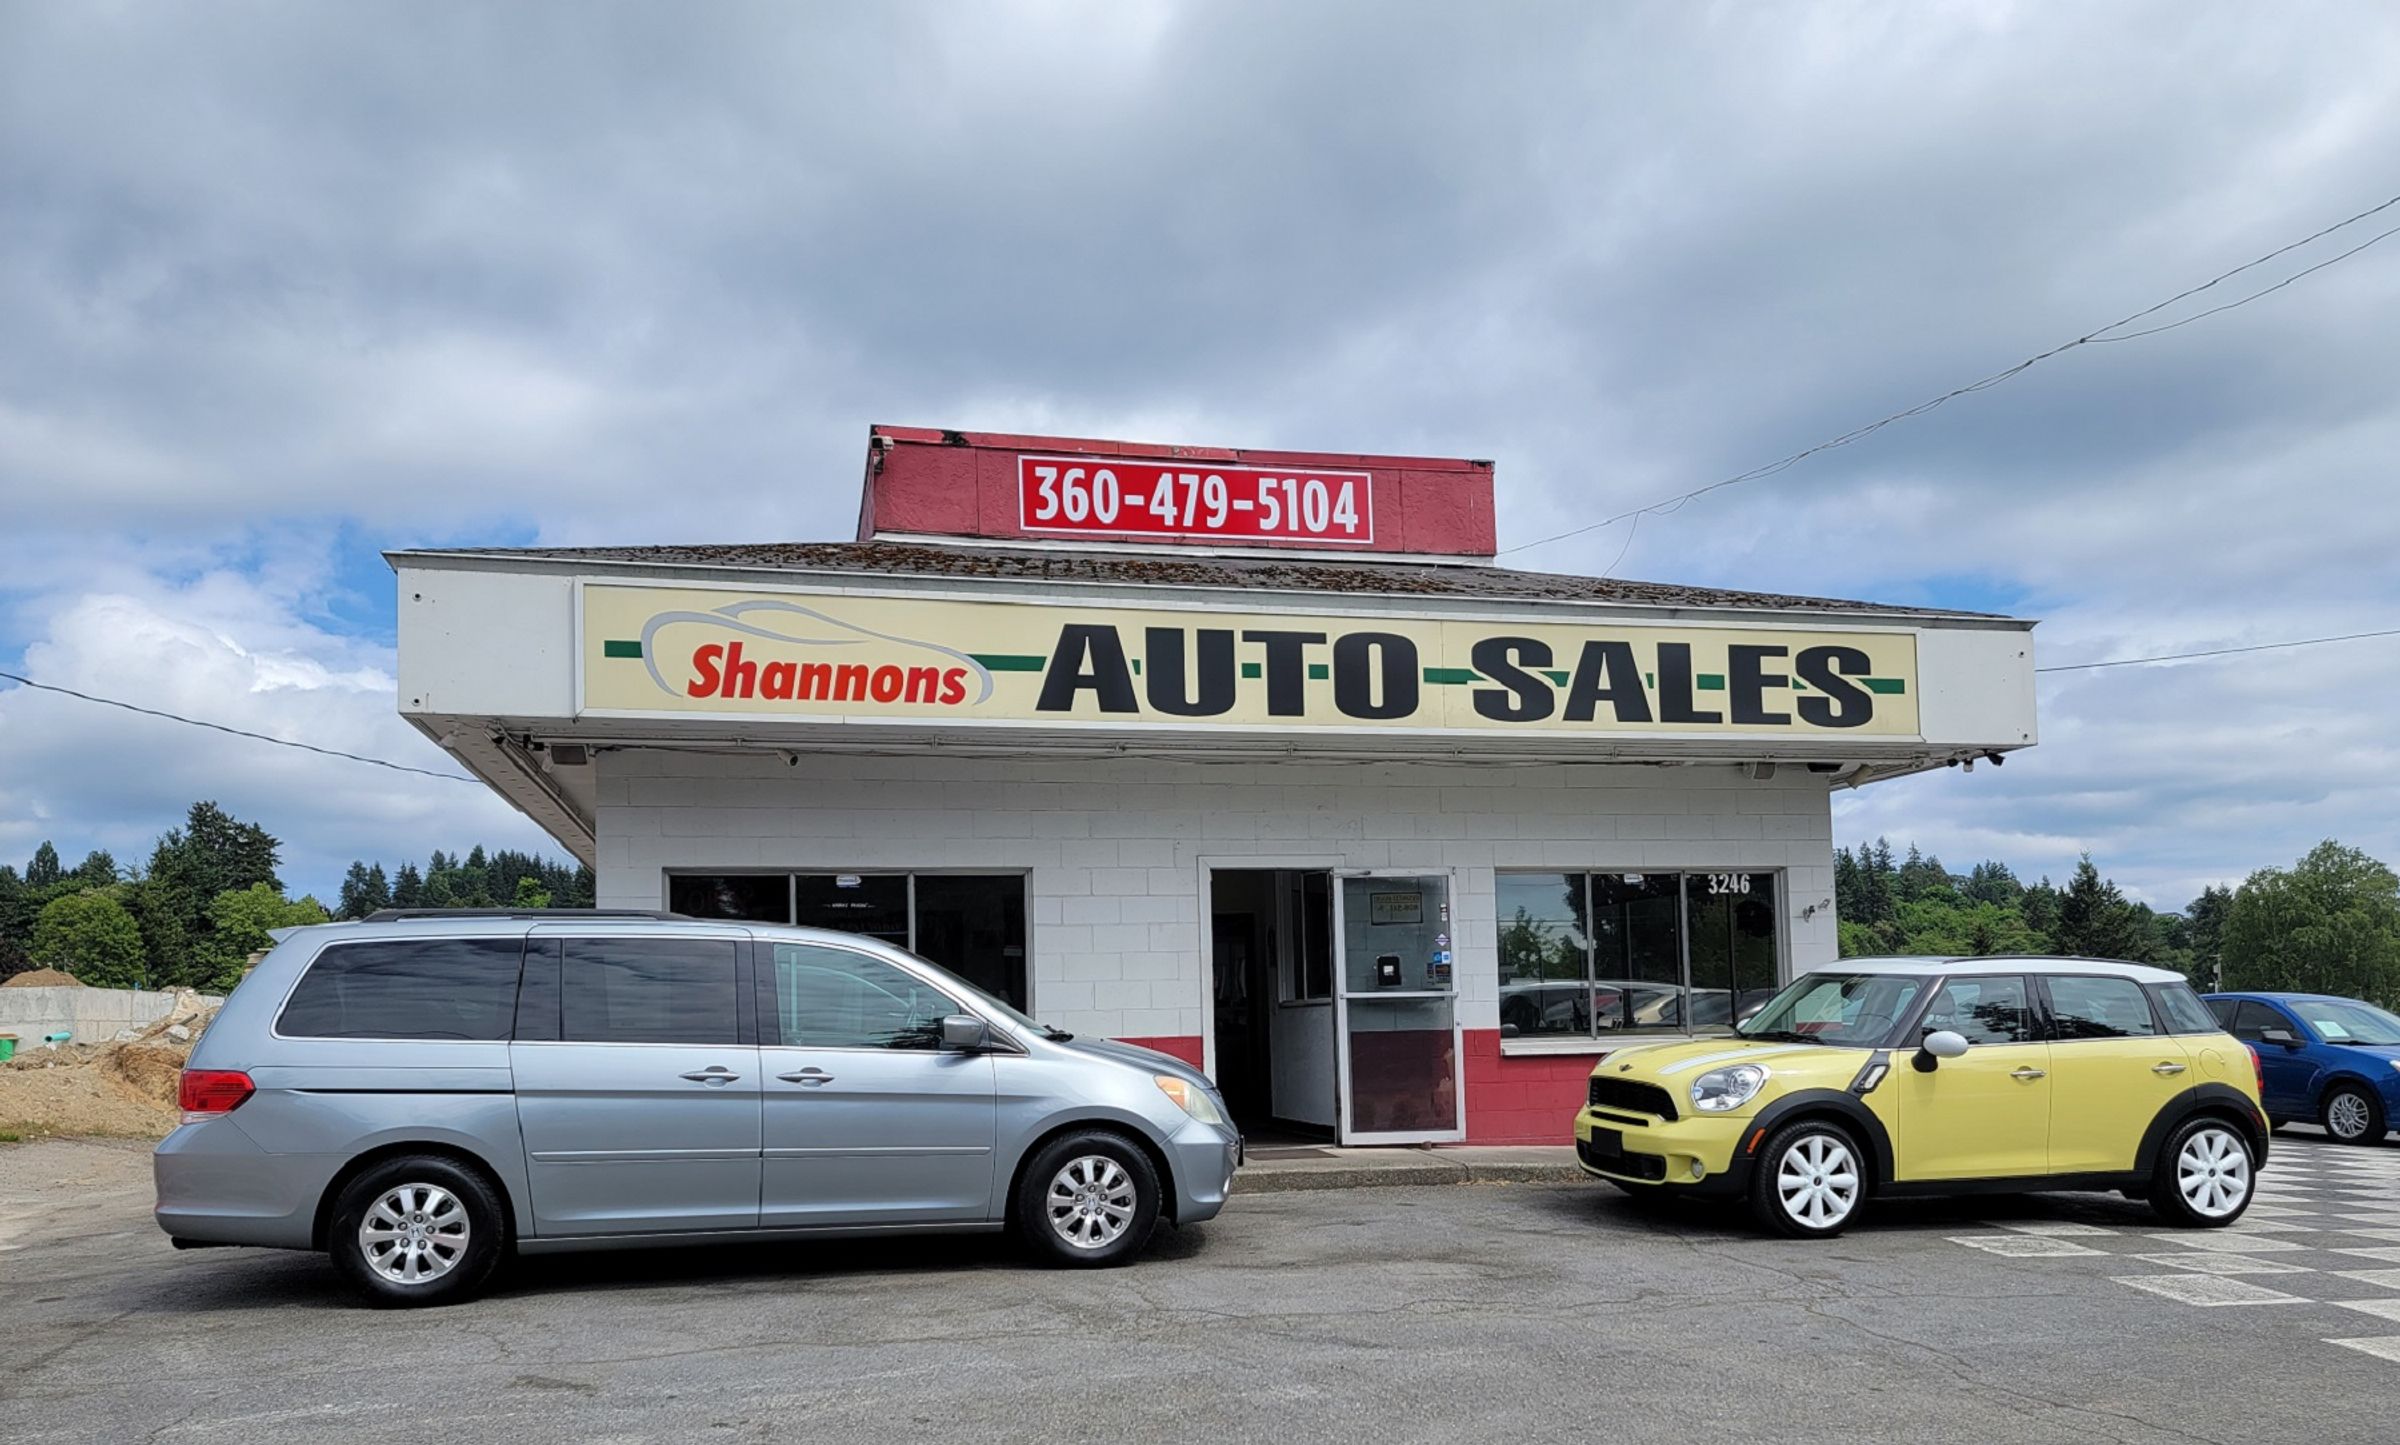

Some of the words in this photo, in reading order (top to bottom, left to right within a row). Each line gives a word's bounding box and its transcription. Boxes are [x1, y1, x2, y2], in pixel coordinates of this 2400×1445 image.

[1034, 466, 1358, 533] 360-479-5104
[687, 641, 968, 706] Shannons
[1035, 623, 1419, 720] AUTO
[1470, 636, 1874, 728] SALES
[1707, 873, 1751, 894] 3246
